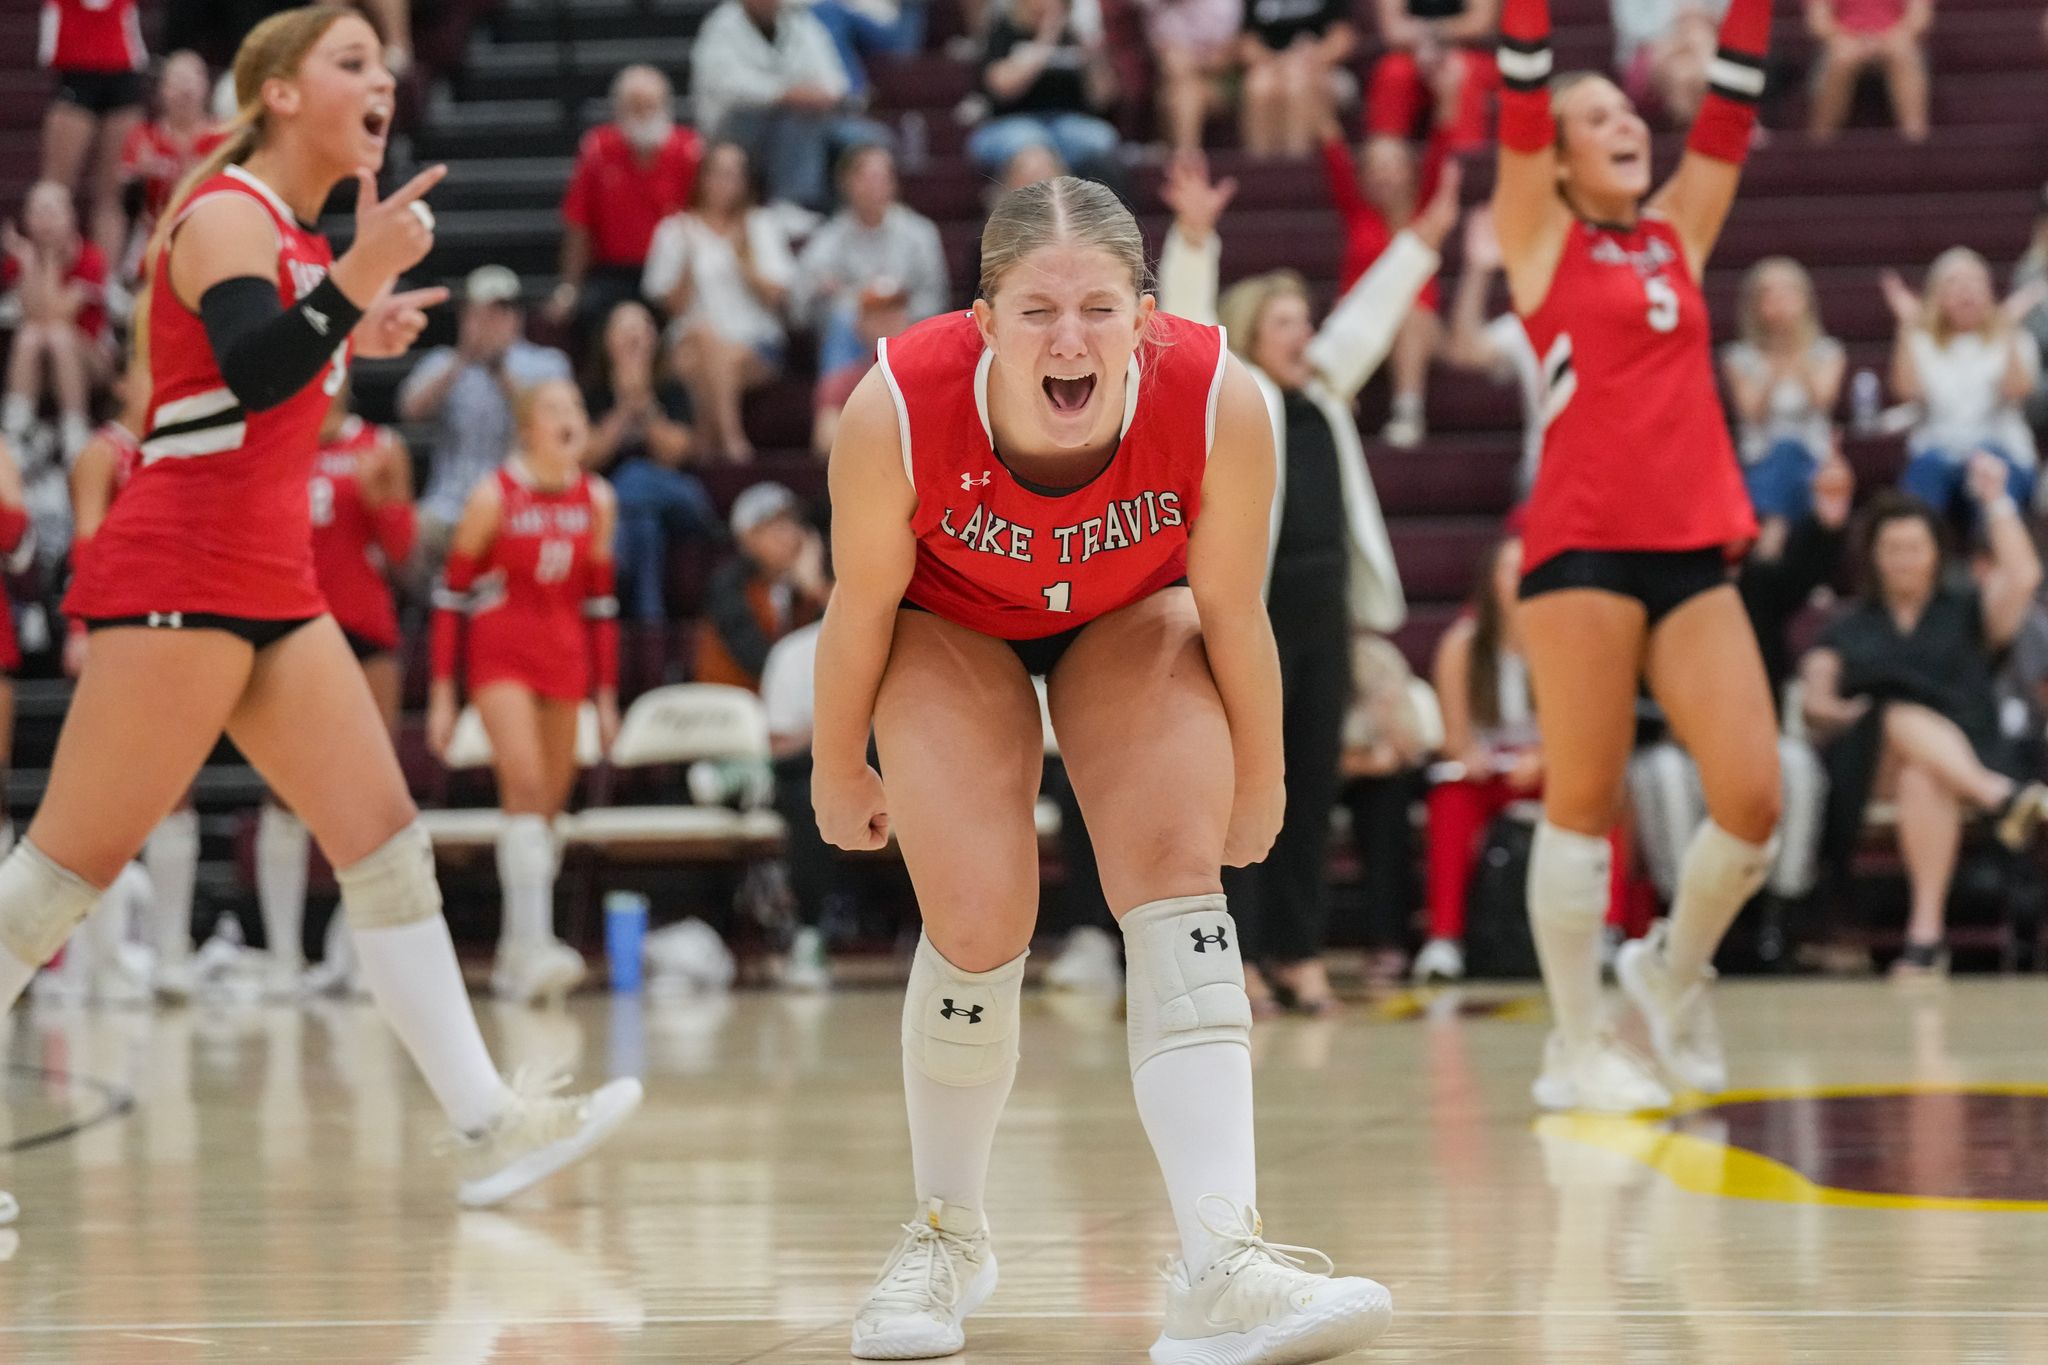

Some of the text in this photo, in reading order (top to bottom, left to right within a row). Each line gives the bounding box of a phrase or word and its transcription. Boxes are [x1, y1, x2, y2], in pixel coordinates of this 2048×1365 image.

[1645, 276, 1679, 332] 5
[940, 491, 1183, 563] LAKE TRAVIS
[1041, 580, 1072, 613] 1
